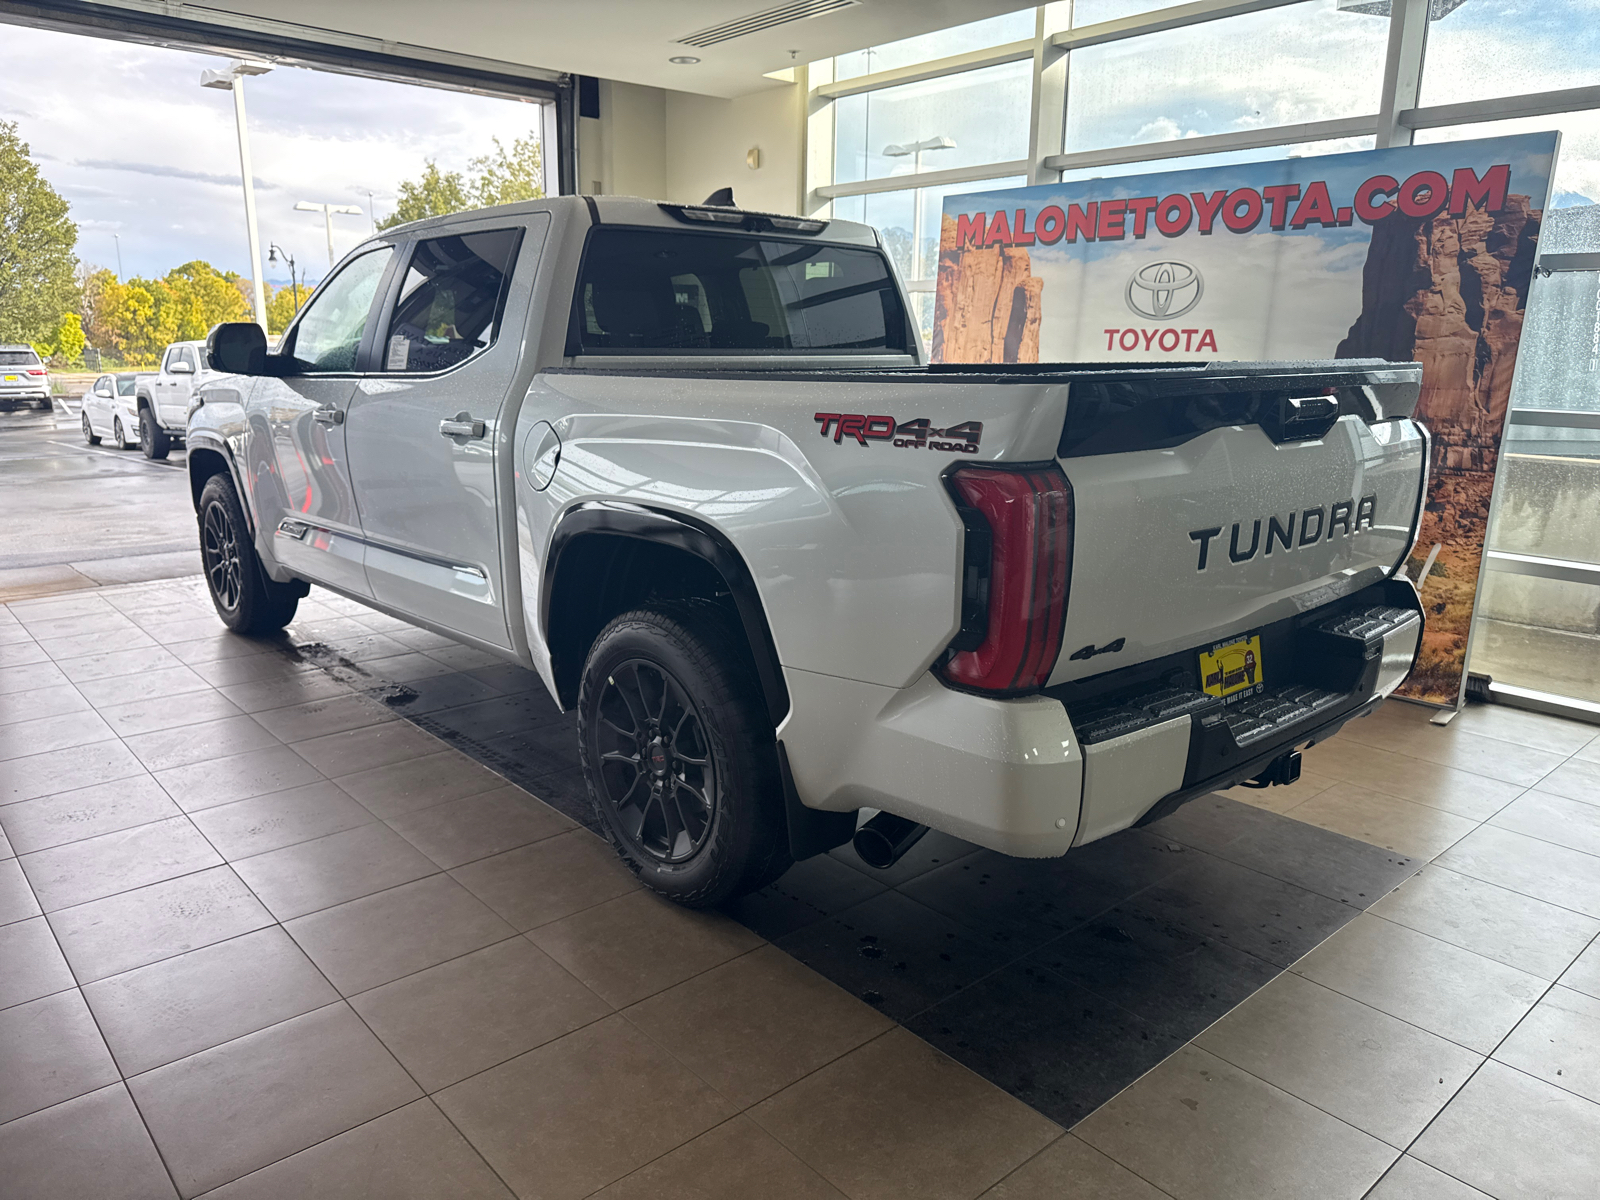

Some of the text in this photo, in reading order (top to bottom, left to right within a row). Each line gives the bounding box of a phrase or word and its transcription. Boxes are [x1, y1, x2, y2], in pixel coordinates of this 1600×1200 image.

[955, 163, 1511, 250] MALONETOYOTA.COM
[1104, 328, 1218, 353] TOYOTA
[814, 412, 897, 447] TRD
[893, 438, 979, 454] OFF ROAD
[1188, 492, 1377, 573] TUNDRA
[1246, 654, 1253, 664] 32
[1227, 694, 1238, 704] MAKE
[1243, 688, 1253, 698] EASY
